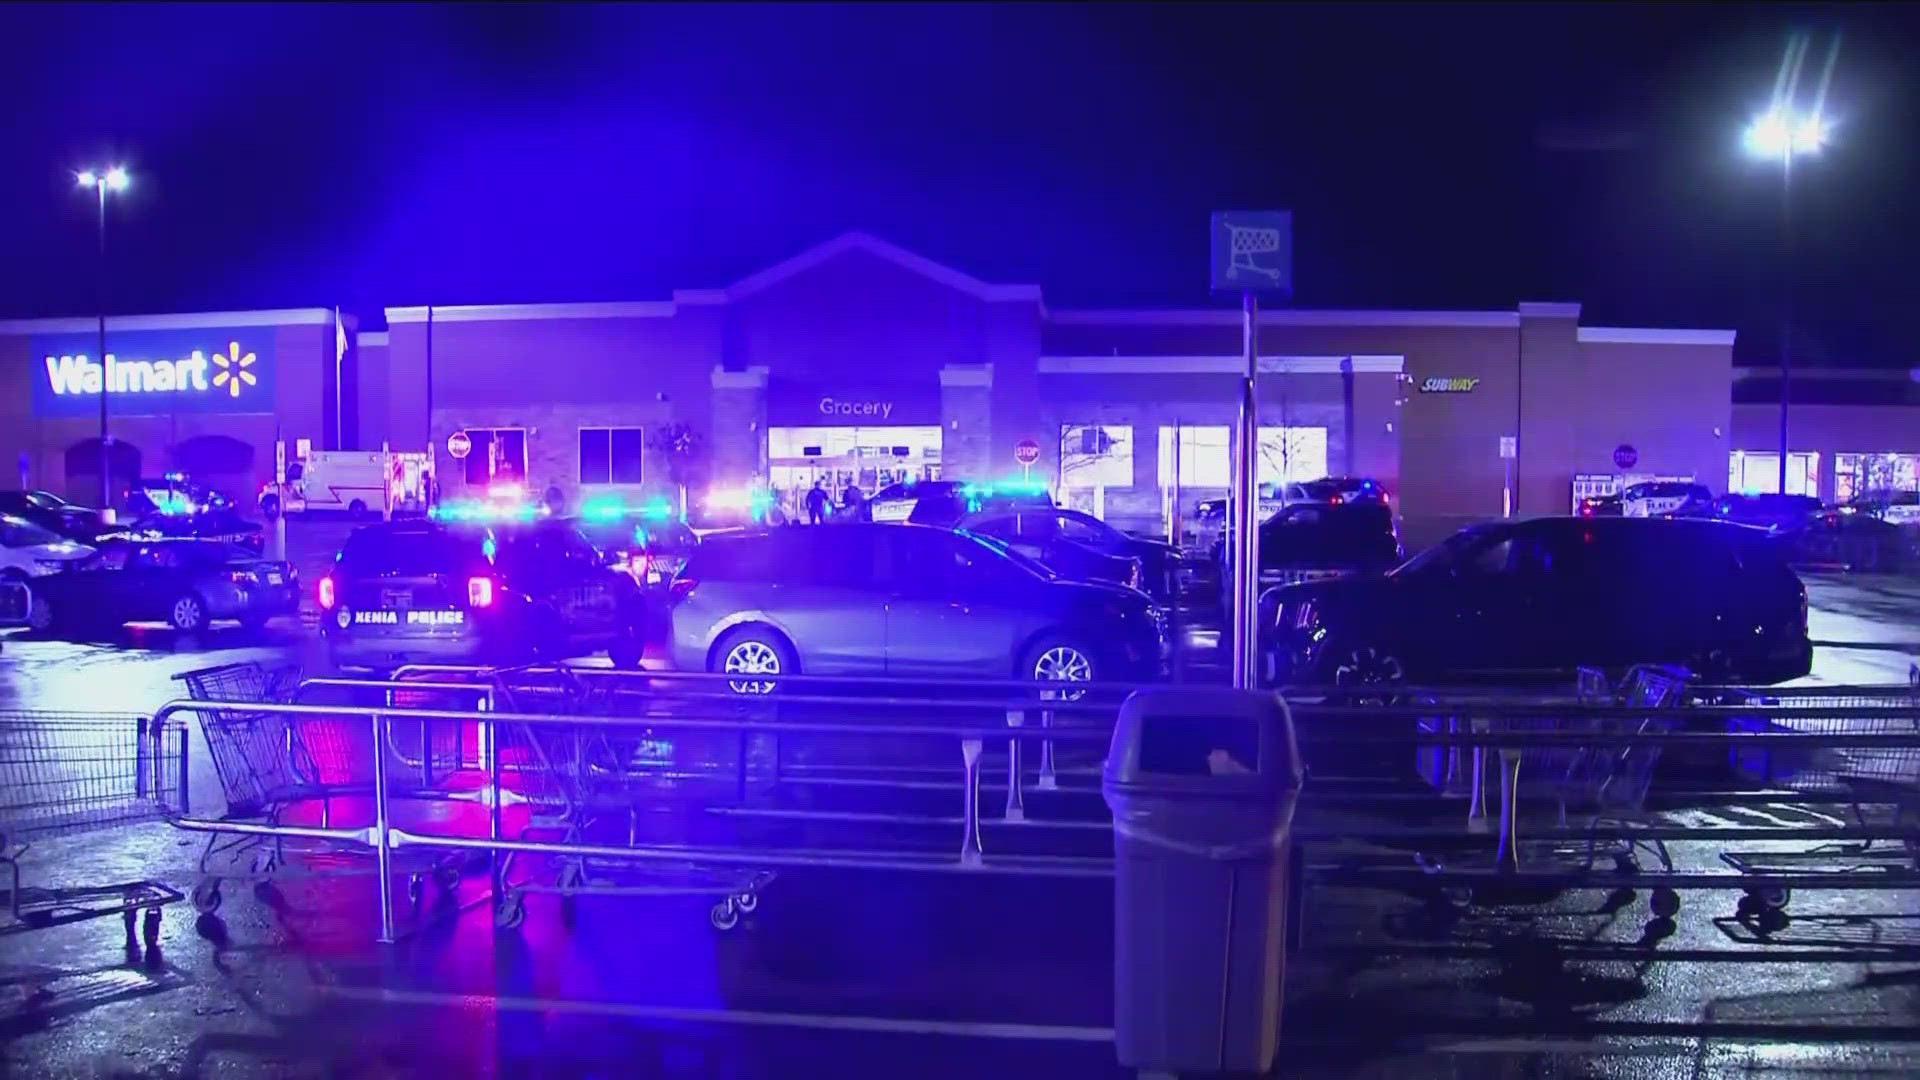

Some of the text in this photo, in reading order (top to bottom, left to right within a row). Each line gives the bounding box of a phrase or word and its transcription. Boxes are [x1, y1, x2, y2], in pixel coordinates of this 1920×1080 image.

[45, 350, 208, 395] Walmart
[1421, 378, 1480, 391] SUBWAY
[819, 397, 892, 419] Grocery
[1016, 446, 1039, 457] STOP
[355, 611, 464, 624] XENIA POLICE
